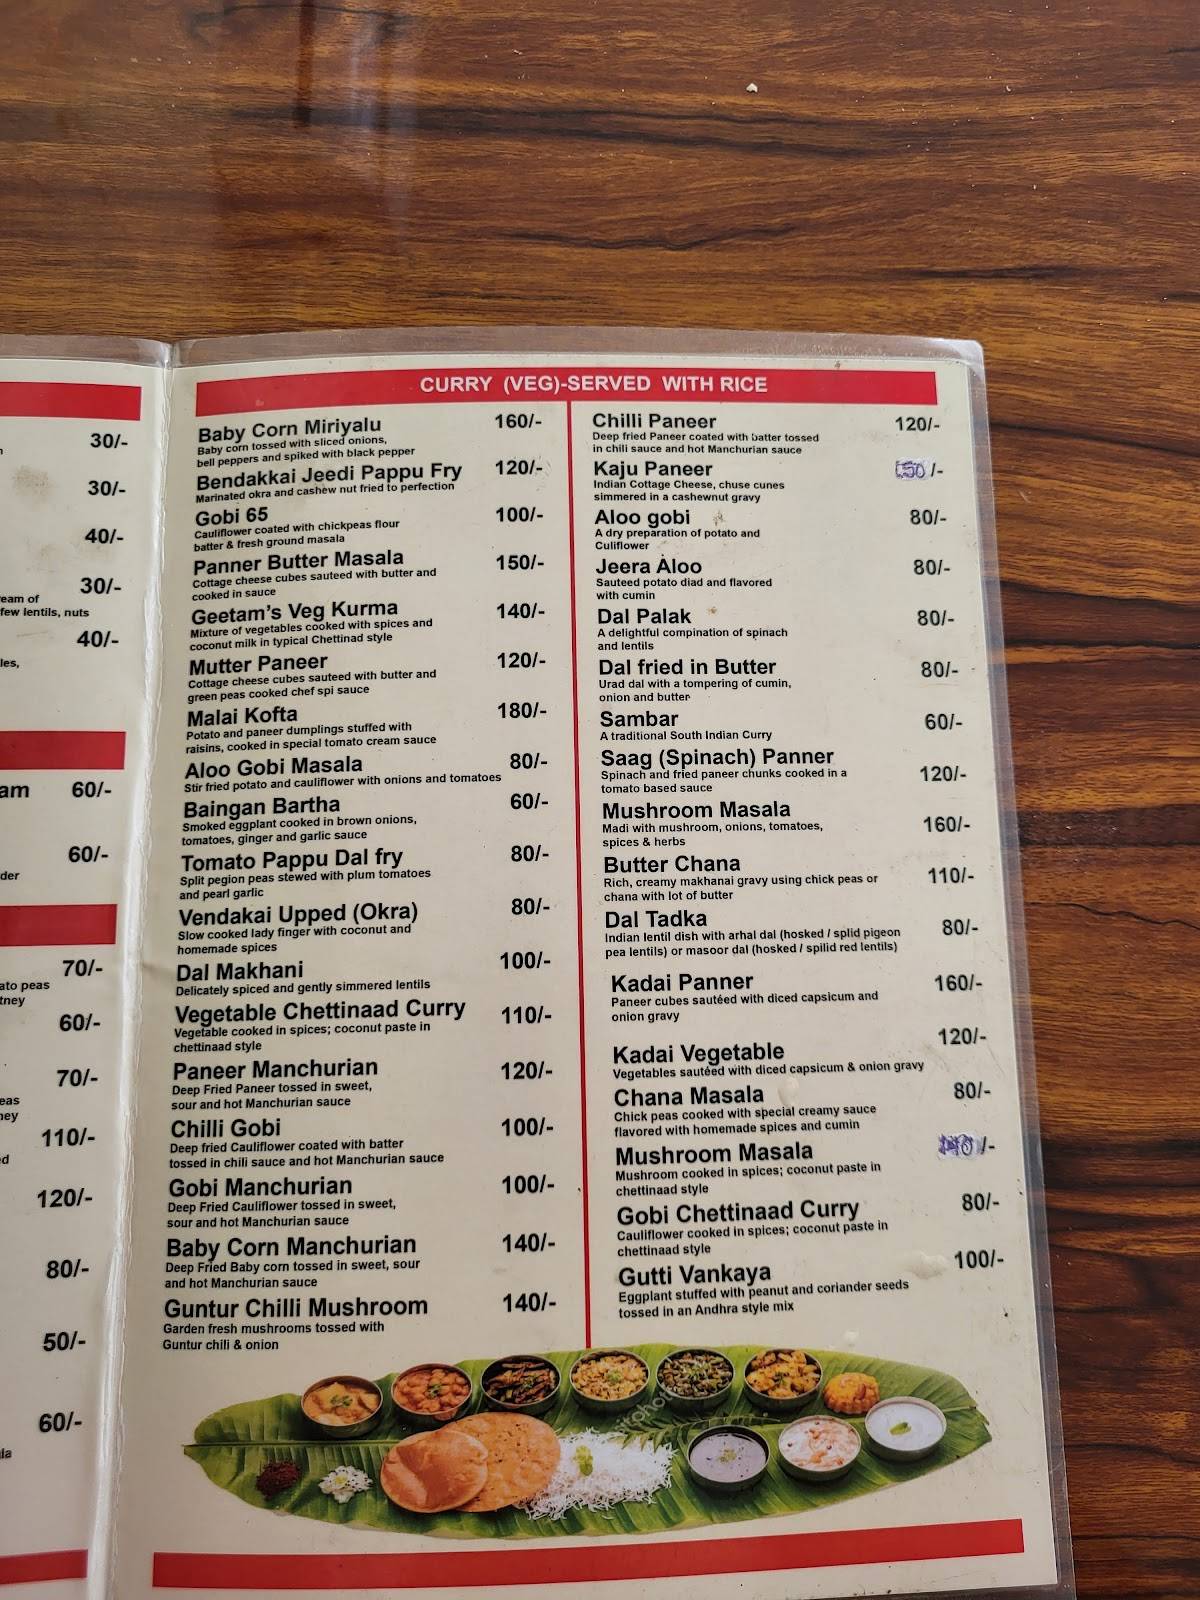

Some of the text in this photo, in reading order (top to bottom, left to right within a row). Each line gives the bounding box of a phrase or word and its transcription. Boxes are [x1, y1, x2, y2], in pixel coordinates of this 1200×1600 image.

[420, 376, 492, 392] CURRY
[662, 376, 713, 391] WITH
[720, 376, 768, 392] RICE
[495, 413, 542, 428] 160/-
[592, 413, 717, 429] Chilli Paneer
[895, 416, 940, 431] 120/-
[198, 417, 381, 444] Baby Corn Miriyalu
[592, 431, 619, 443] Deep
[622, 432, 646, 440] fried
[650, 432, 686, 441] Paneer
[689, 432, 724, 441] coated
[727, 433, 748, 441] with
[784, 433, 819, 442] tossed
[90, 433, 128, 449] 30/-
[197, 436, 387, 456] Baby corn tossed with sliced onions,
[495, 459, 543, 475] 120/-
[197, 462, 462, 491] Bendakkai Jeedi Pappu Fry
[195, 506, 268, 527] Gobi 65
[496, 507, 543, 522] 100/-
[594, 509, 690, 529] Aloo gobi
[910, 509, 947, 525] 80/-
[84, 528, 124, 544] 40/-
[194, 520, 400, 539] Cauliflower coated with chickpeas flour
[595, 528, 760, 540] A dry preparation of potato and
[595, 541, 649, 550] Culiflower
[595, 558, 702, 574] Jeera Aloo
[914, 559, 950, 575] 80/-
[28, 594, 40, 603] of
[23, 607, 61, 618] lentils,
[64, 609, 89, 617] nuts
[187, 705, 297, 727] Malai Kofta
[498, 702, 547, 718] 180/-
[600, 710, 679, 727] Sambar
[925, 713, 963, 730] 60/-
[600, 730, 772, 741] A traditional South Indian Curry
[184, 755, 363, 779] Aloo Gobi Masala
[510, 752, 548, 770] 80/-
[601, 748, 834, 769] Saag (Spinach) Panner
[920, 765, 966, 782] 120/-
[72, 781, 112, 798] 60/-
[184, 773, 502, 793] Stir fried potato and cauliflower with onions and tomatoes
[604, 855, 741, 873] Butter Chana
[928, 867, 974, 884] 110/-
[604, 890, 733, 902] chana with lot of butter
[179, 901, 418, 926] Vendakai Upped (Okra)
[511, 897, 550, 915] 80/-
[605, 909, 707, 929] Dal Tadka
[942, 918, 978, 936] 80/-
[62, 959, 103, 977] 70/-
[500, 951, 551, 969] 100/-
[176, 960, 303, 982] Dal Makhani
[21, 982, 50, 993] peas
[176, 979, 431, 997] Delicately spiced and gently simmered lentils
[611, 973, 754, 993] Kadai Panner
[935, 974, 982, 991] 160/-
[611, 1011, 680, 1023] onion gravy
[173, 1058, 378, 1080] Paneer Manchurian
[501, 1060, 553, 1080] 120/-
[42, 1127, 95, 1147] 110/-
[616, 1142, 813, 1166] Mushroom Masala
[37, 1187, 93, 1208] 120/-
[962, 1192, 999, 1211] 80/-
[617, 1200, 859, 1226] Gobi Chettinaad Curry
[954, 1249, 1004, 1269] 100/-
[618, 1263, 771, 1287] Gutti Vankaya
[164, 1297, 428, 1318] Guntur Chilli Mushroom
[503, 1292, 556, 1313] 140/-
[619, 1300, 794, 1319] tossed in an Andhra style mix
[163, 1321, 384, 1334] Garden fresh mushrooms tossed with
[43, 1330, 86, 1352] 50/-
[162, 1339, 279, 1350] Guntur chili & onion
